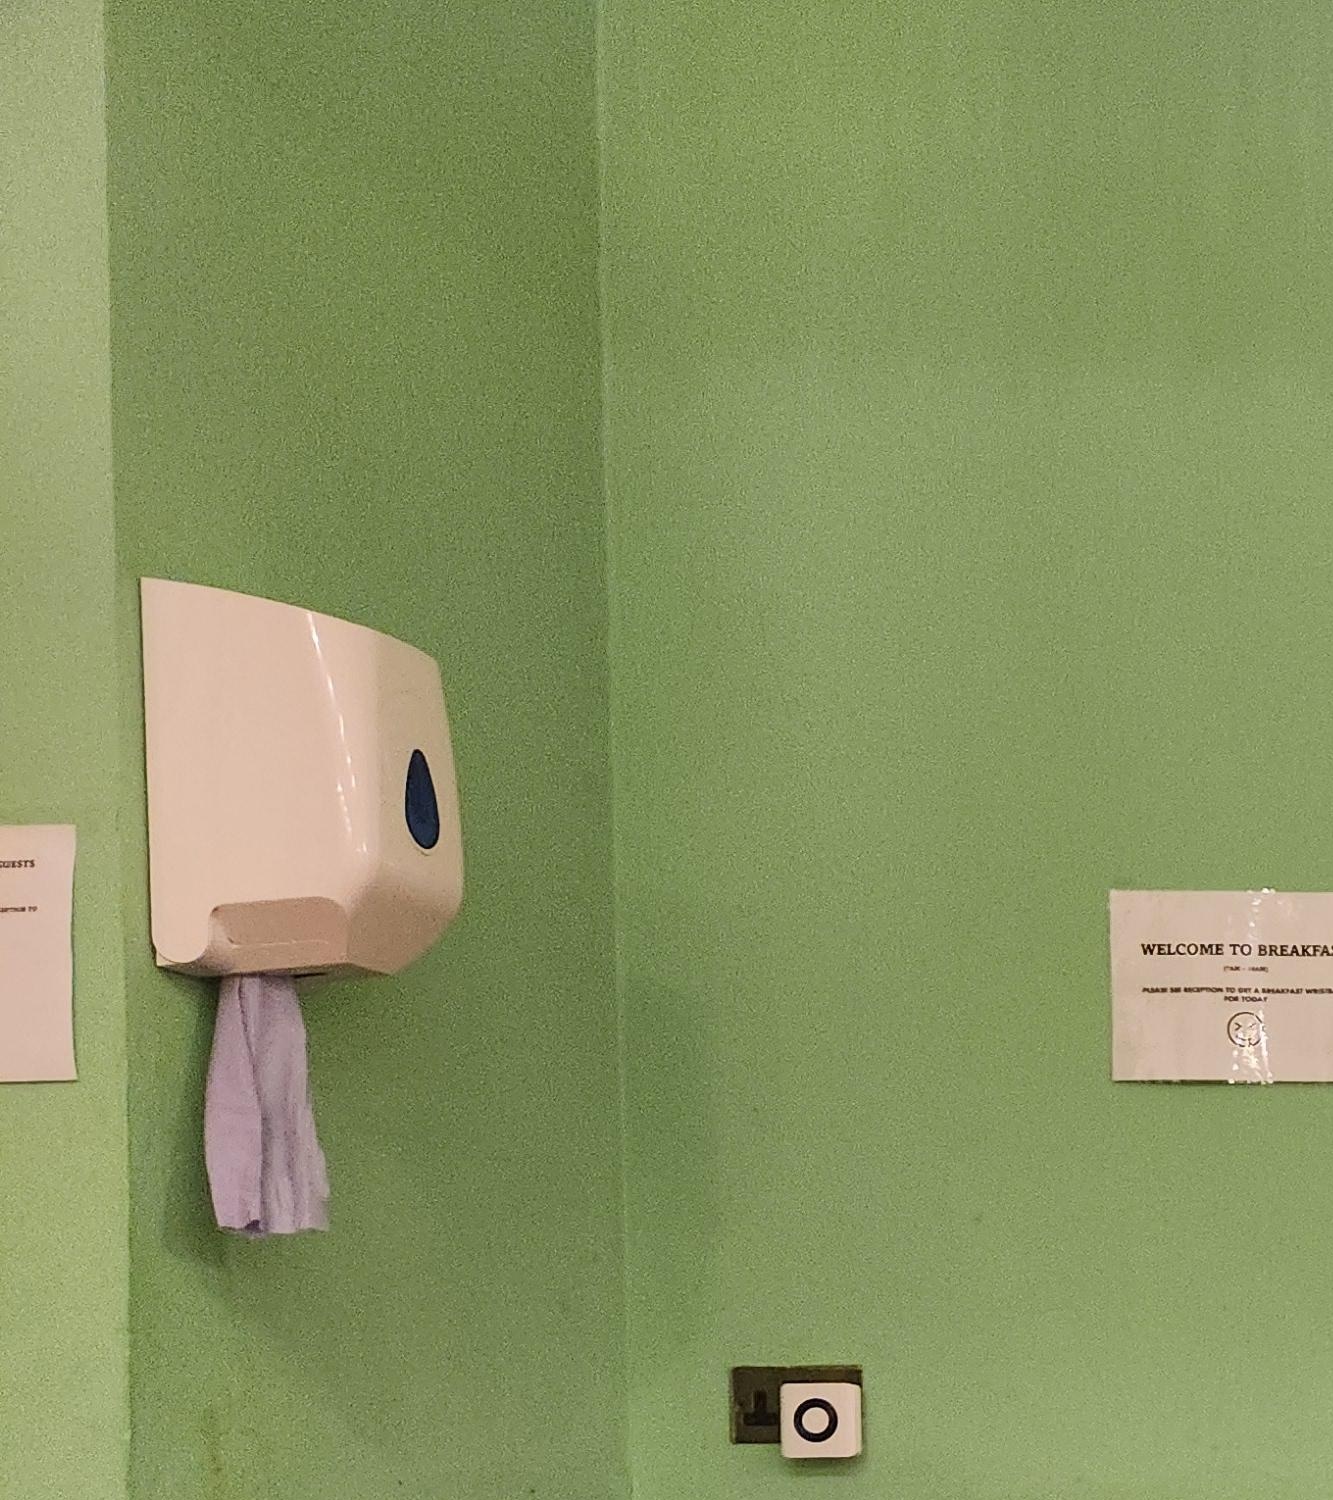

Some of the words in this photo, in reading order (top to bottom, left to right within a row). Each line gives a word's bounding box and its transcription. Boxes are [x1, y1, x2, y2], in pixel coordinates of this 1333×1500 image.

[1140, 942, 1225, 957] WELCOME
[1229, 943, 1253, 957] TO
[1184, 986, 1224, 994] RECEPTION
[1226, 986, 1236, 994] TO
[1253, 987, 1260, 995] A
[1241, 995, 1269, 1003] TODAY
